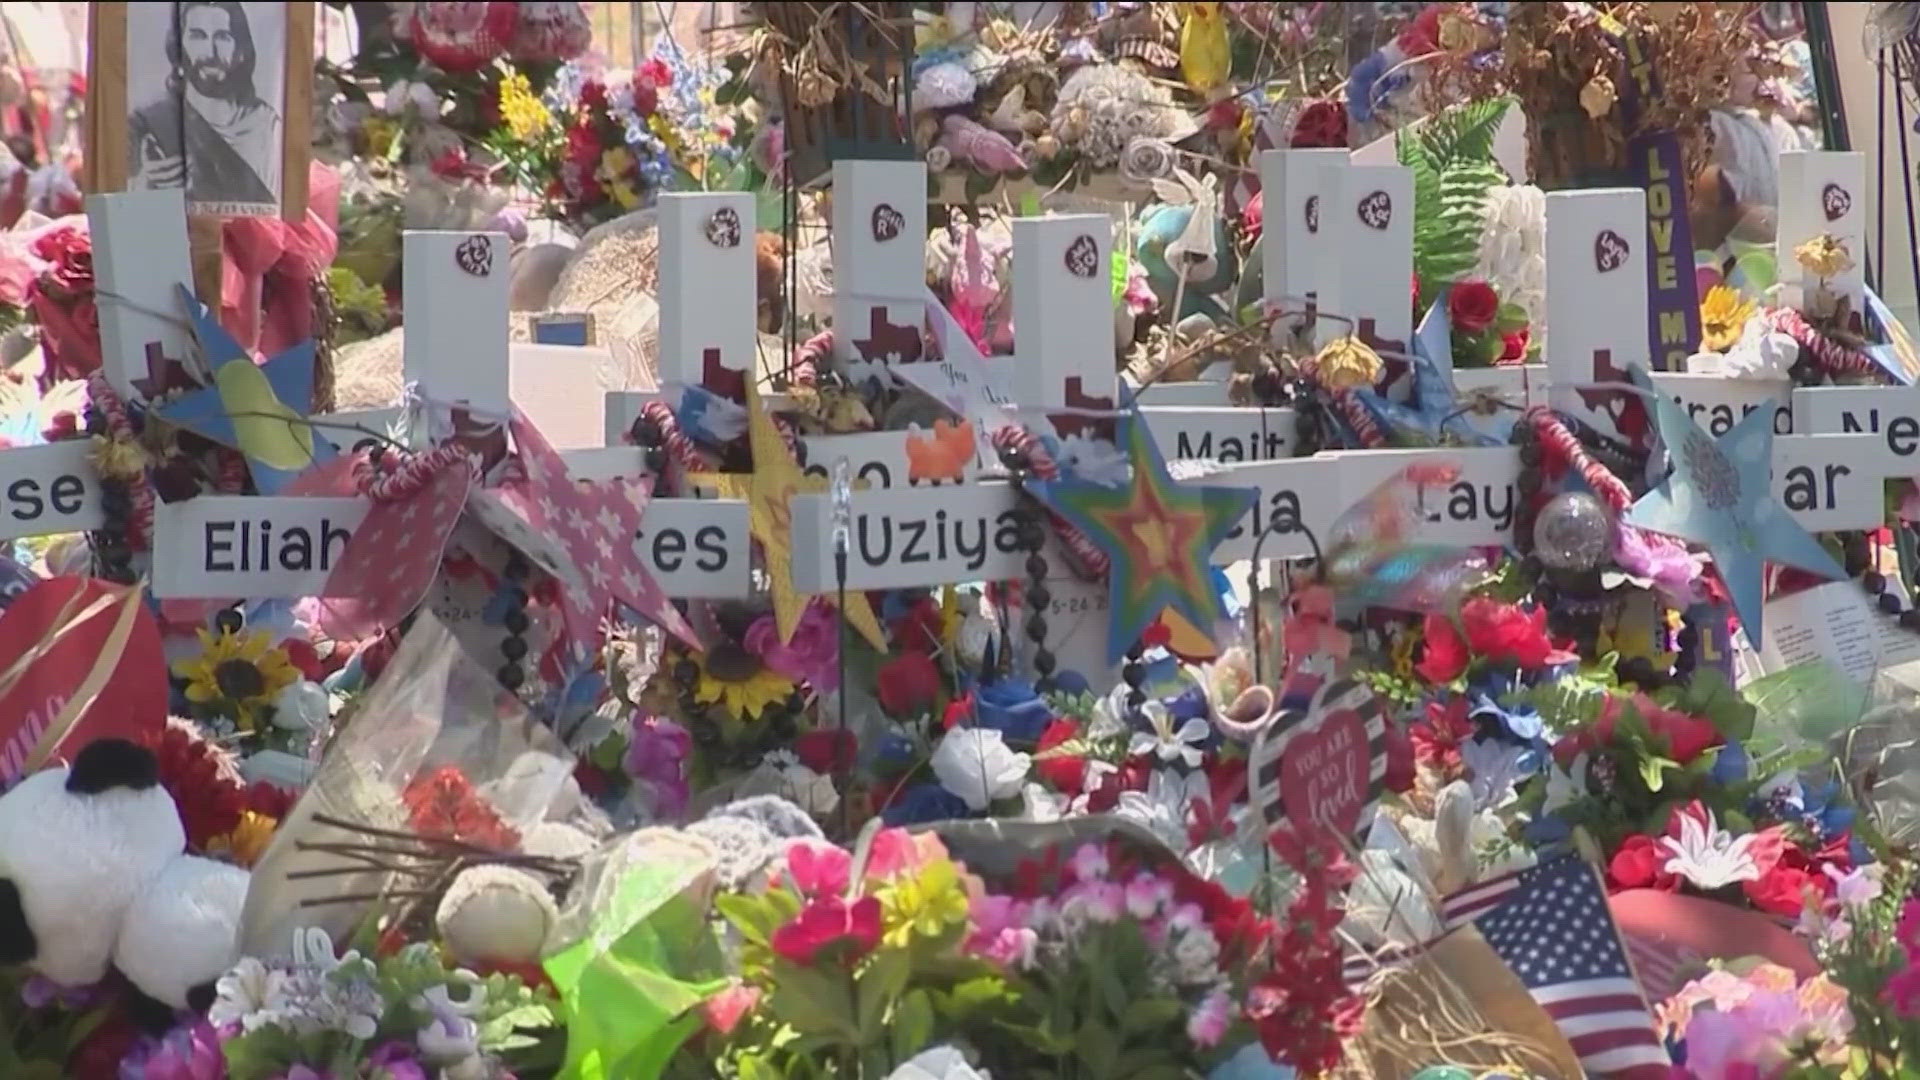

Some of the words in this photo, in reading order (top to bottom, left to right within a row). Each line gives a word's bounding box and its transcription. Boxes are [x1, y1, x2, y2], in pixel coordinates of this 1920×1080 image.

[1647, 147, 1678, 290] LOVE
[0, 475, 85, 520] se
[1417, 481, 1513, 532] Lay
[1769, 463, 1851, 512] ar
[1225, 488, 1301, 540] la
[205, 519, 352, 572] Eliah
[636, 526, 728, 573] es
[858, 509, 1025, 571] Uziya
[1295, 745, 1321, 777] YOU
[1326, 724, 1353, 757] ARE
[1321, 763, 1339, 789] SO
